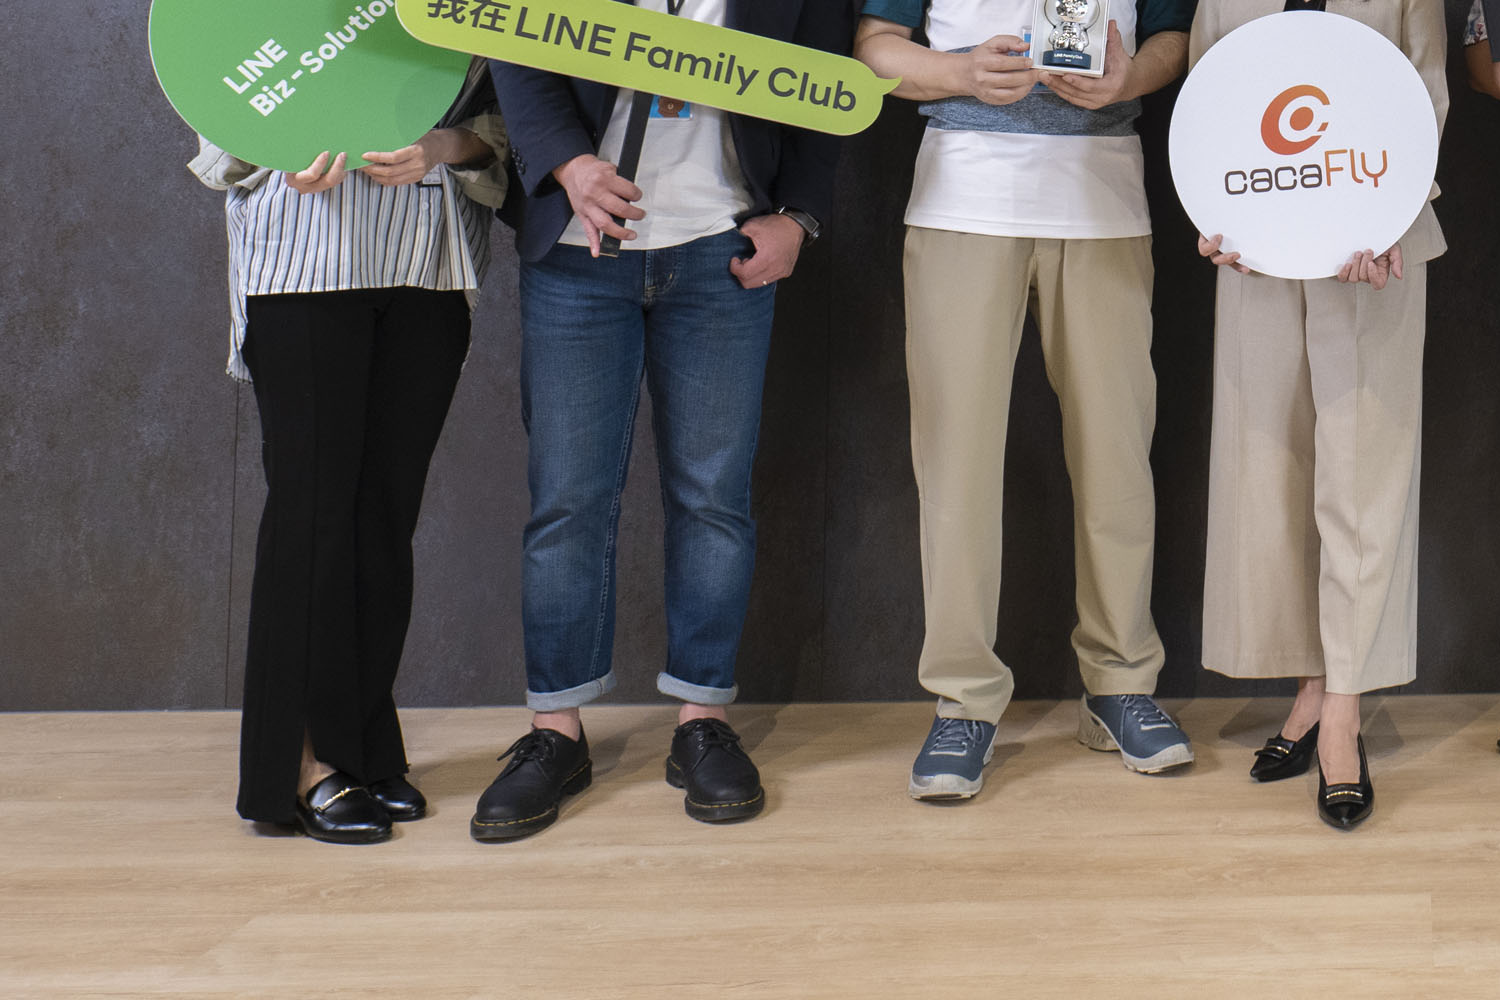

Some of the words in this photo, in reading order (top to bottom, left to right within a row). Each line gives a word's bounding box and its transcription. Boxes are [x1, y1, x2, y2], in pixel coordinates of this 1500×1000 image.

[222, 38, 289, 95] LINE
[514, 6, 617, 57] LINE
[623, 31, 759, 96] Family
[767, 66, 857, 112] Club
[1224, 148, 1389, 195] cacaFly
